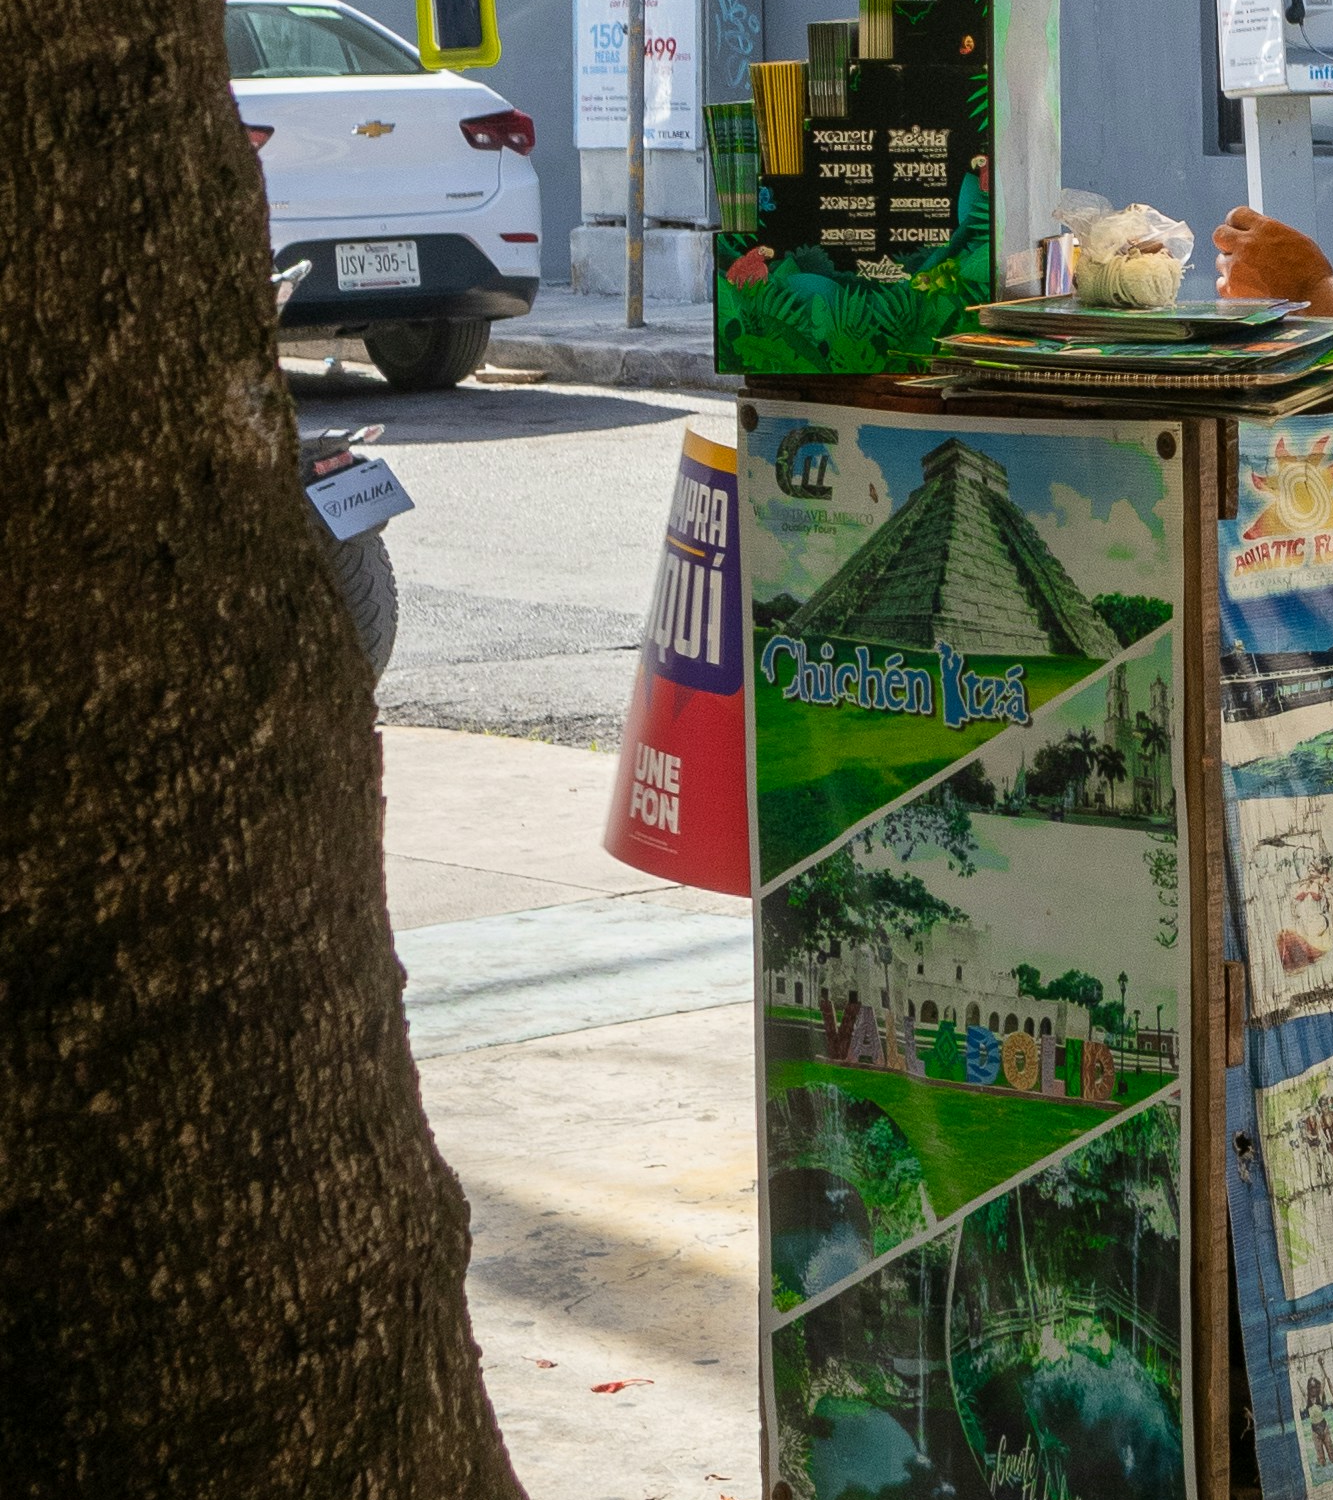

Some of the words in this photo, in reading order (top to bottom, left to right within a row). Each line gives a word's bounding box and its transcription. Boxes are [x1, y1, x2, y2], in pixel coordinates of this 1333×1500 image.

[590, 22, 624, 50] 150
[594, 50, 620, 64] MEGAS
[657, 130, 690, 139] TELMEX
[889, 228, 950, 241] XICHEN
[340, 253, 416, 276] USV-305-L
[343, 480, 394, 511] ITALIKA
[813, 525, 838, 536] Tours
[1234, 537, 1306, 578] AQUATIC
[761, 635, 933, 716] Chichén
[635, 742, 682, 796] UNE
[630, 781, 681, 835] FON
[820, 998, 1116, 1101] VALLADOLID
